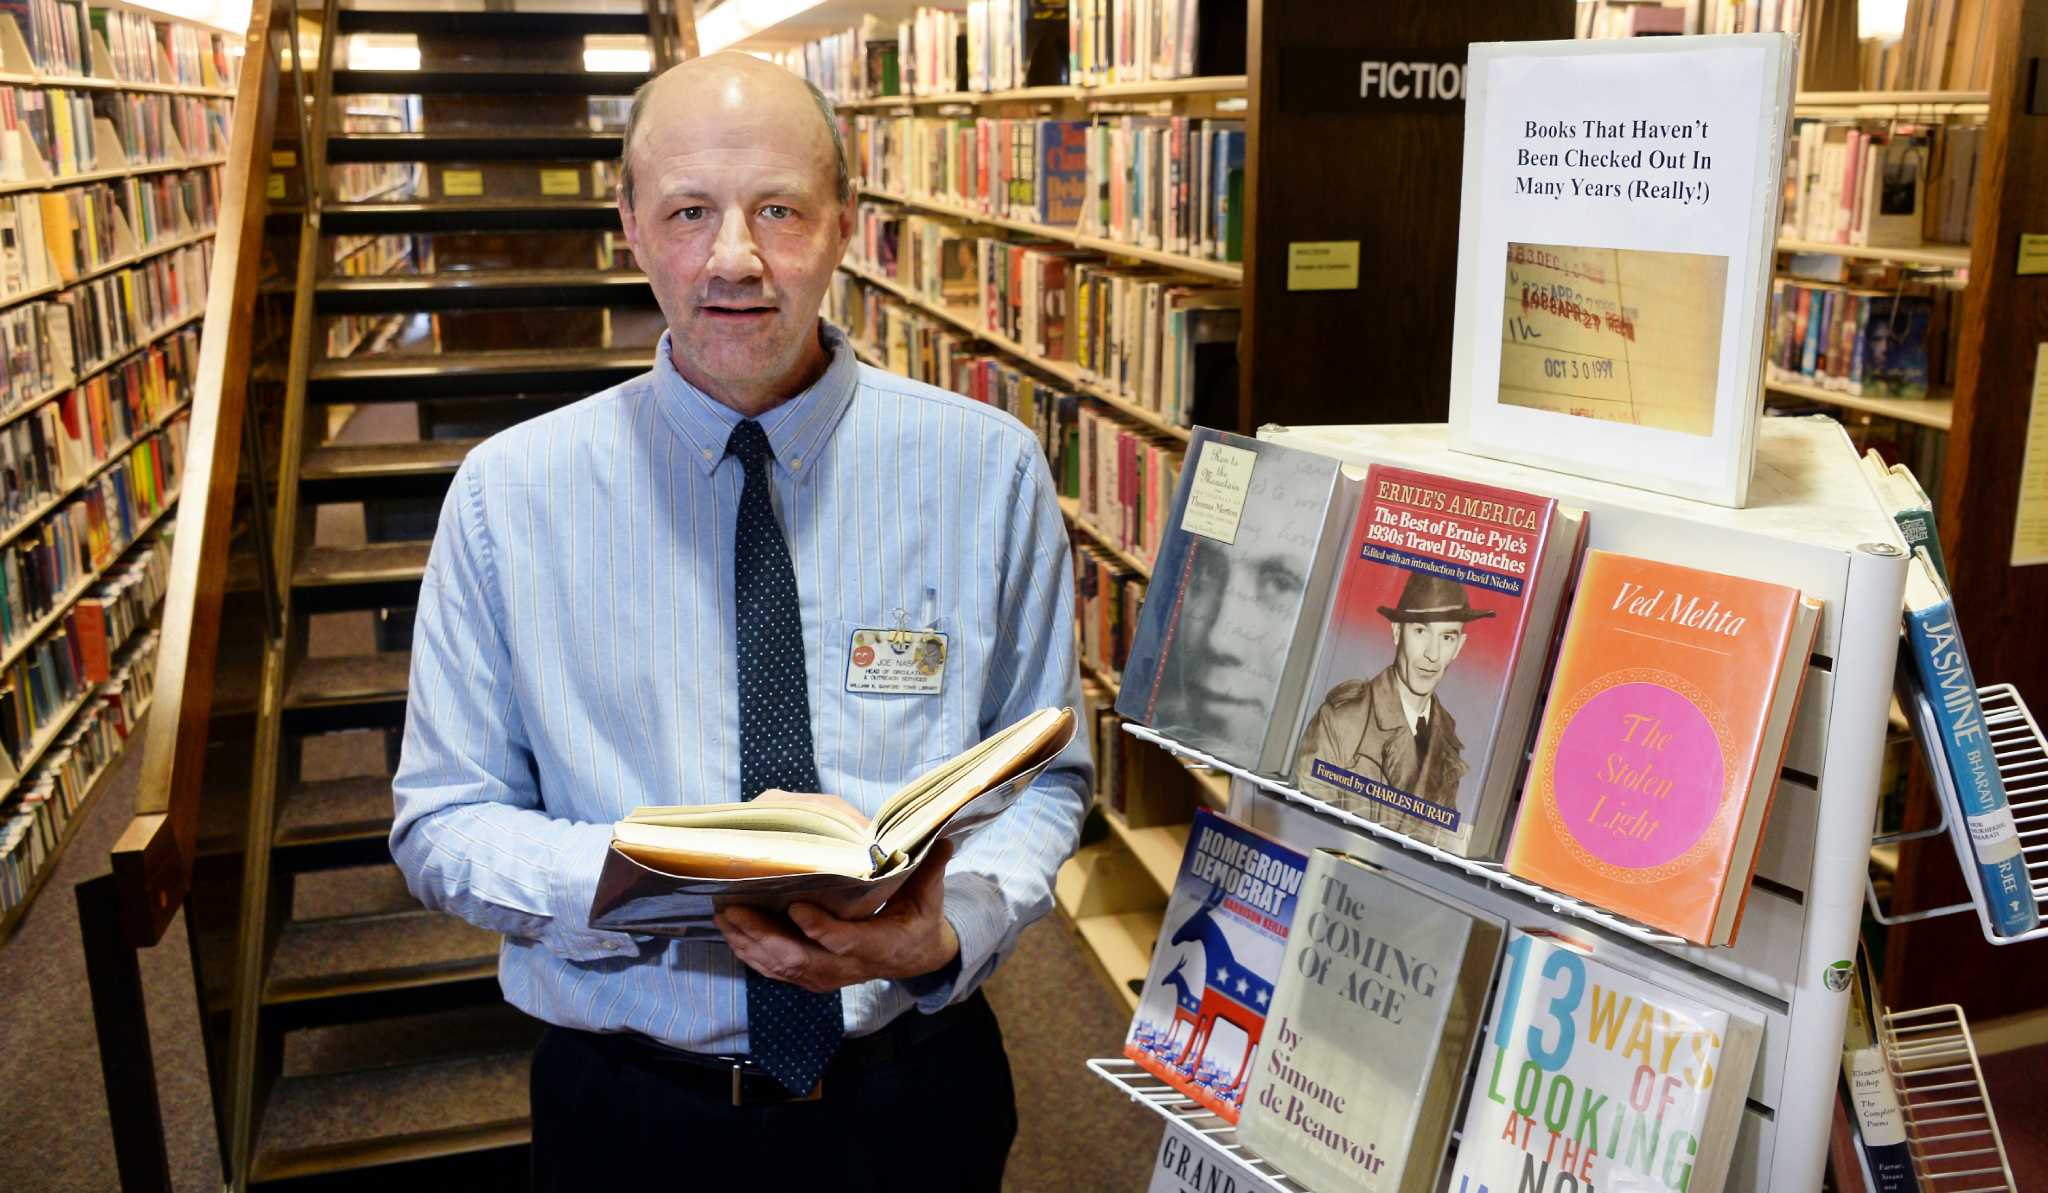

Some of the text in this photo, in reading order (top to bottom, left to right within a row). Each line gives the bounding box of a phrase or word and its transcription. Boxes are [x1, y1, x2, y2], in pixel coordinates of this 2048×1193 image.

[1524, 119, 1709, 139] Books That Haven't
[1517, 149, 1712, 169] Been Checked Out In
[1515, 177, 1710, 205] Many Years (Really!)
[1544, 358, 1567, 378] OCT
[1191, 496, 1214, 510] Thomas
[1377, 480, 1537, 530] ERNIE'S AMERICA
[1366, 523, 1526, 574] 1930s Travel Dispatches
[1374, 506, 1527, 555] The Best of Ernie Pyle's
[1362, 545, 1520, 593] Edited with an introduction by David Nichols
[1611, 582, 1747, 638] Ved Mehta
[877, 659, 891, 667] JOE
[1922, 621, 1984, 747] JASMINE
[1623, 712, 1674, 752] The
[1316, 763, 1455, 826] Foreword by CHARLES KURALT
[1596, 752, 1675, 799] Stolen
[1967, 750, 1995, 810] BHARATI
[1587, 794, 1660, 842] Light
[1190, 852, 1288, 917] DEMOCRAT
[1198, 826, 1304, 897] HOMEGROW
[1320, 873, 1365, 921] The
[1307, 911, 1438, 998] COMING
[1297, 946, 1406, 1025] Of AGE
[1277, 1017, 1303, 1052] by
[1494, 935, 1720, 1089] 13 WAYS
[1267, 1048, 1346, 1114] Simone
[1629, 1065, 1682, 1120] OF
[1856, 1079, 1880, 1088] Bishop
[1860, 1099, 1875, 1108] The
[1259, 1084, 1283, 1114] de
[1285, 1096, 1385, 1175] Beauvoir
[1502, 1110, 1536, 1150] AT
[1546, 1130, 1598, 1185] THE
[1162, 1135, 1236, 1193] GRAND
